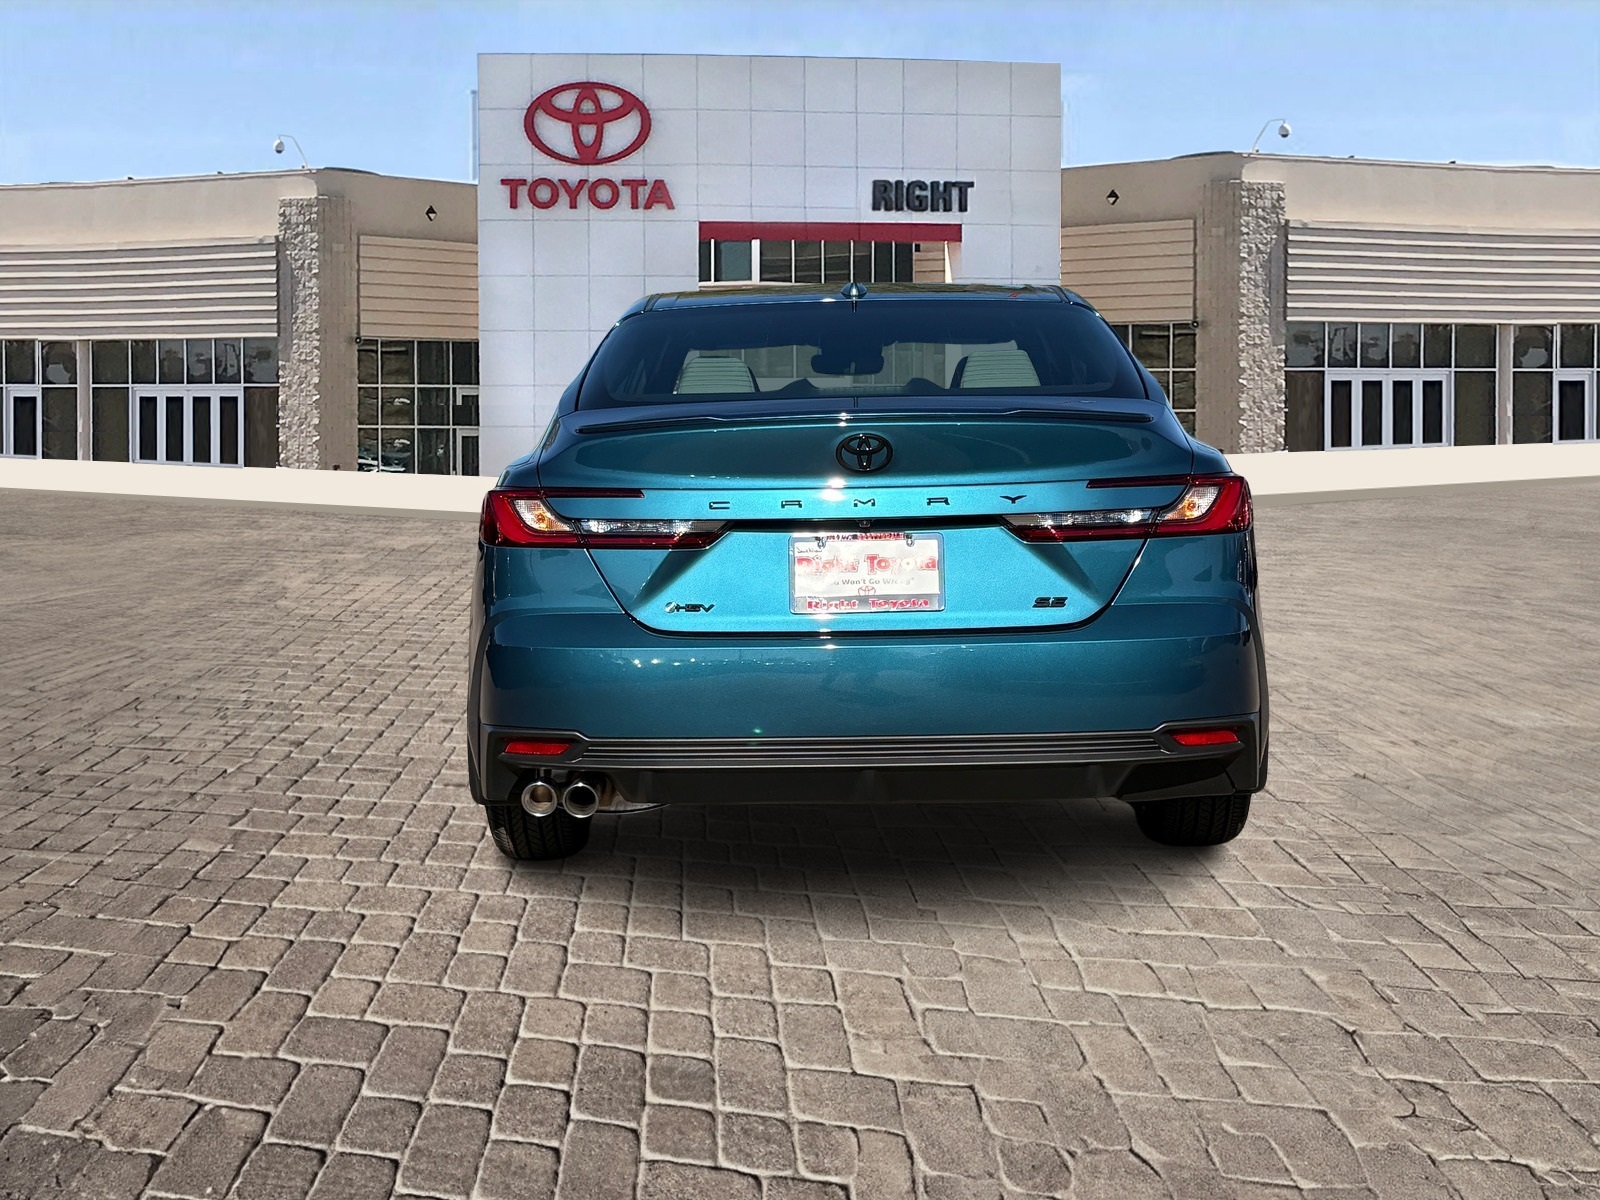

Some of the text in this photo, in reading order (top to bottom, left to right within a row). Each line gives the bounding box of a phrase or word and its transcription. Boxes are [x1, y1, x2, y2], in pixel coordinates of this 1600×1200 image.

[501, 178, 675, 210] TOYOTA
[871, 179, 975, 213] RIGHT
[708, 494, 1027, 509] CAMRY
[864, 553, 938, 576] Toya
[1032, 596, 1069, 609] SE
